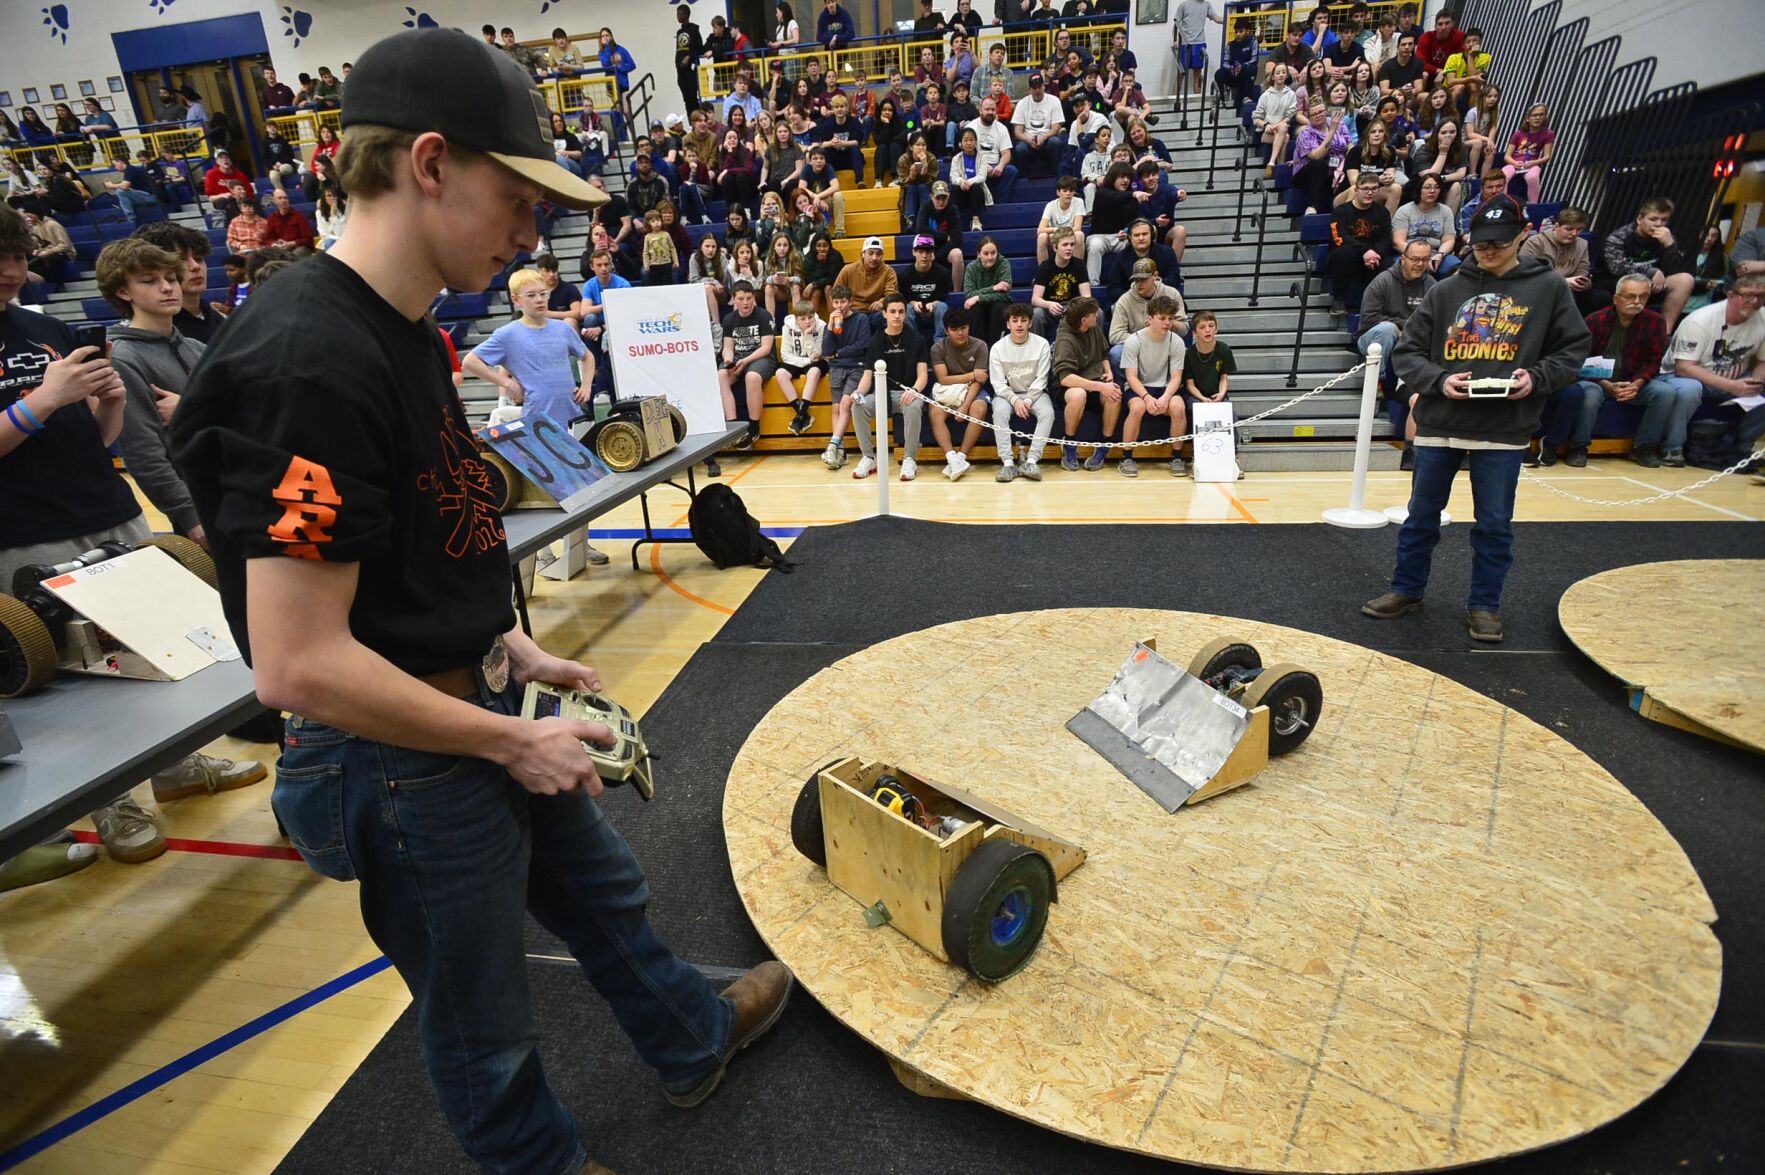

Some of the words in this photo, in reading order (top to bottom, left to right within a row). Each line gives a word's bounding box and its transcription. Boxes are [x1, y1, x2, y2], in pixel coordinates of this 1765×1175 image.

[1485, 209, 1503, 219] 43
[638, 320, 672, 328] TECH
[638, 325, 682, 334] WARS
[628, 340, 699, 357] SUMO-BOTS
[1201, 437, 1224, 455] 63
